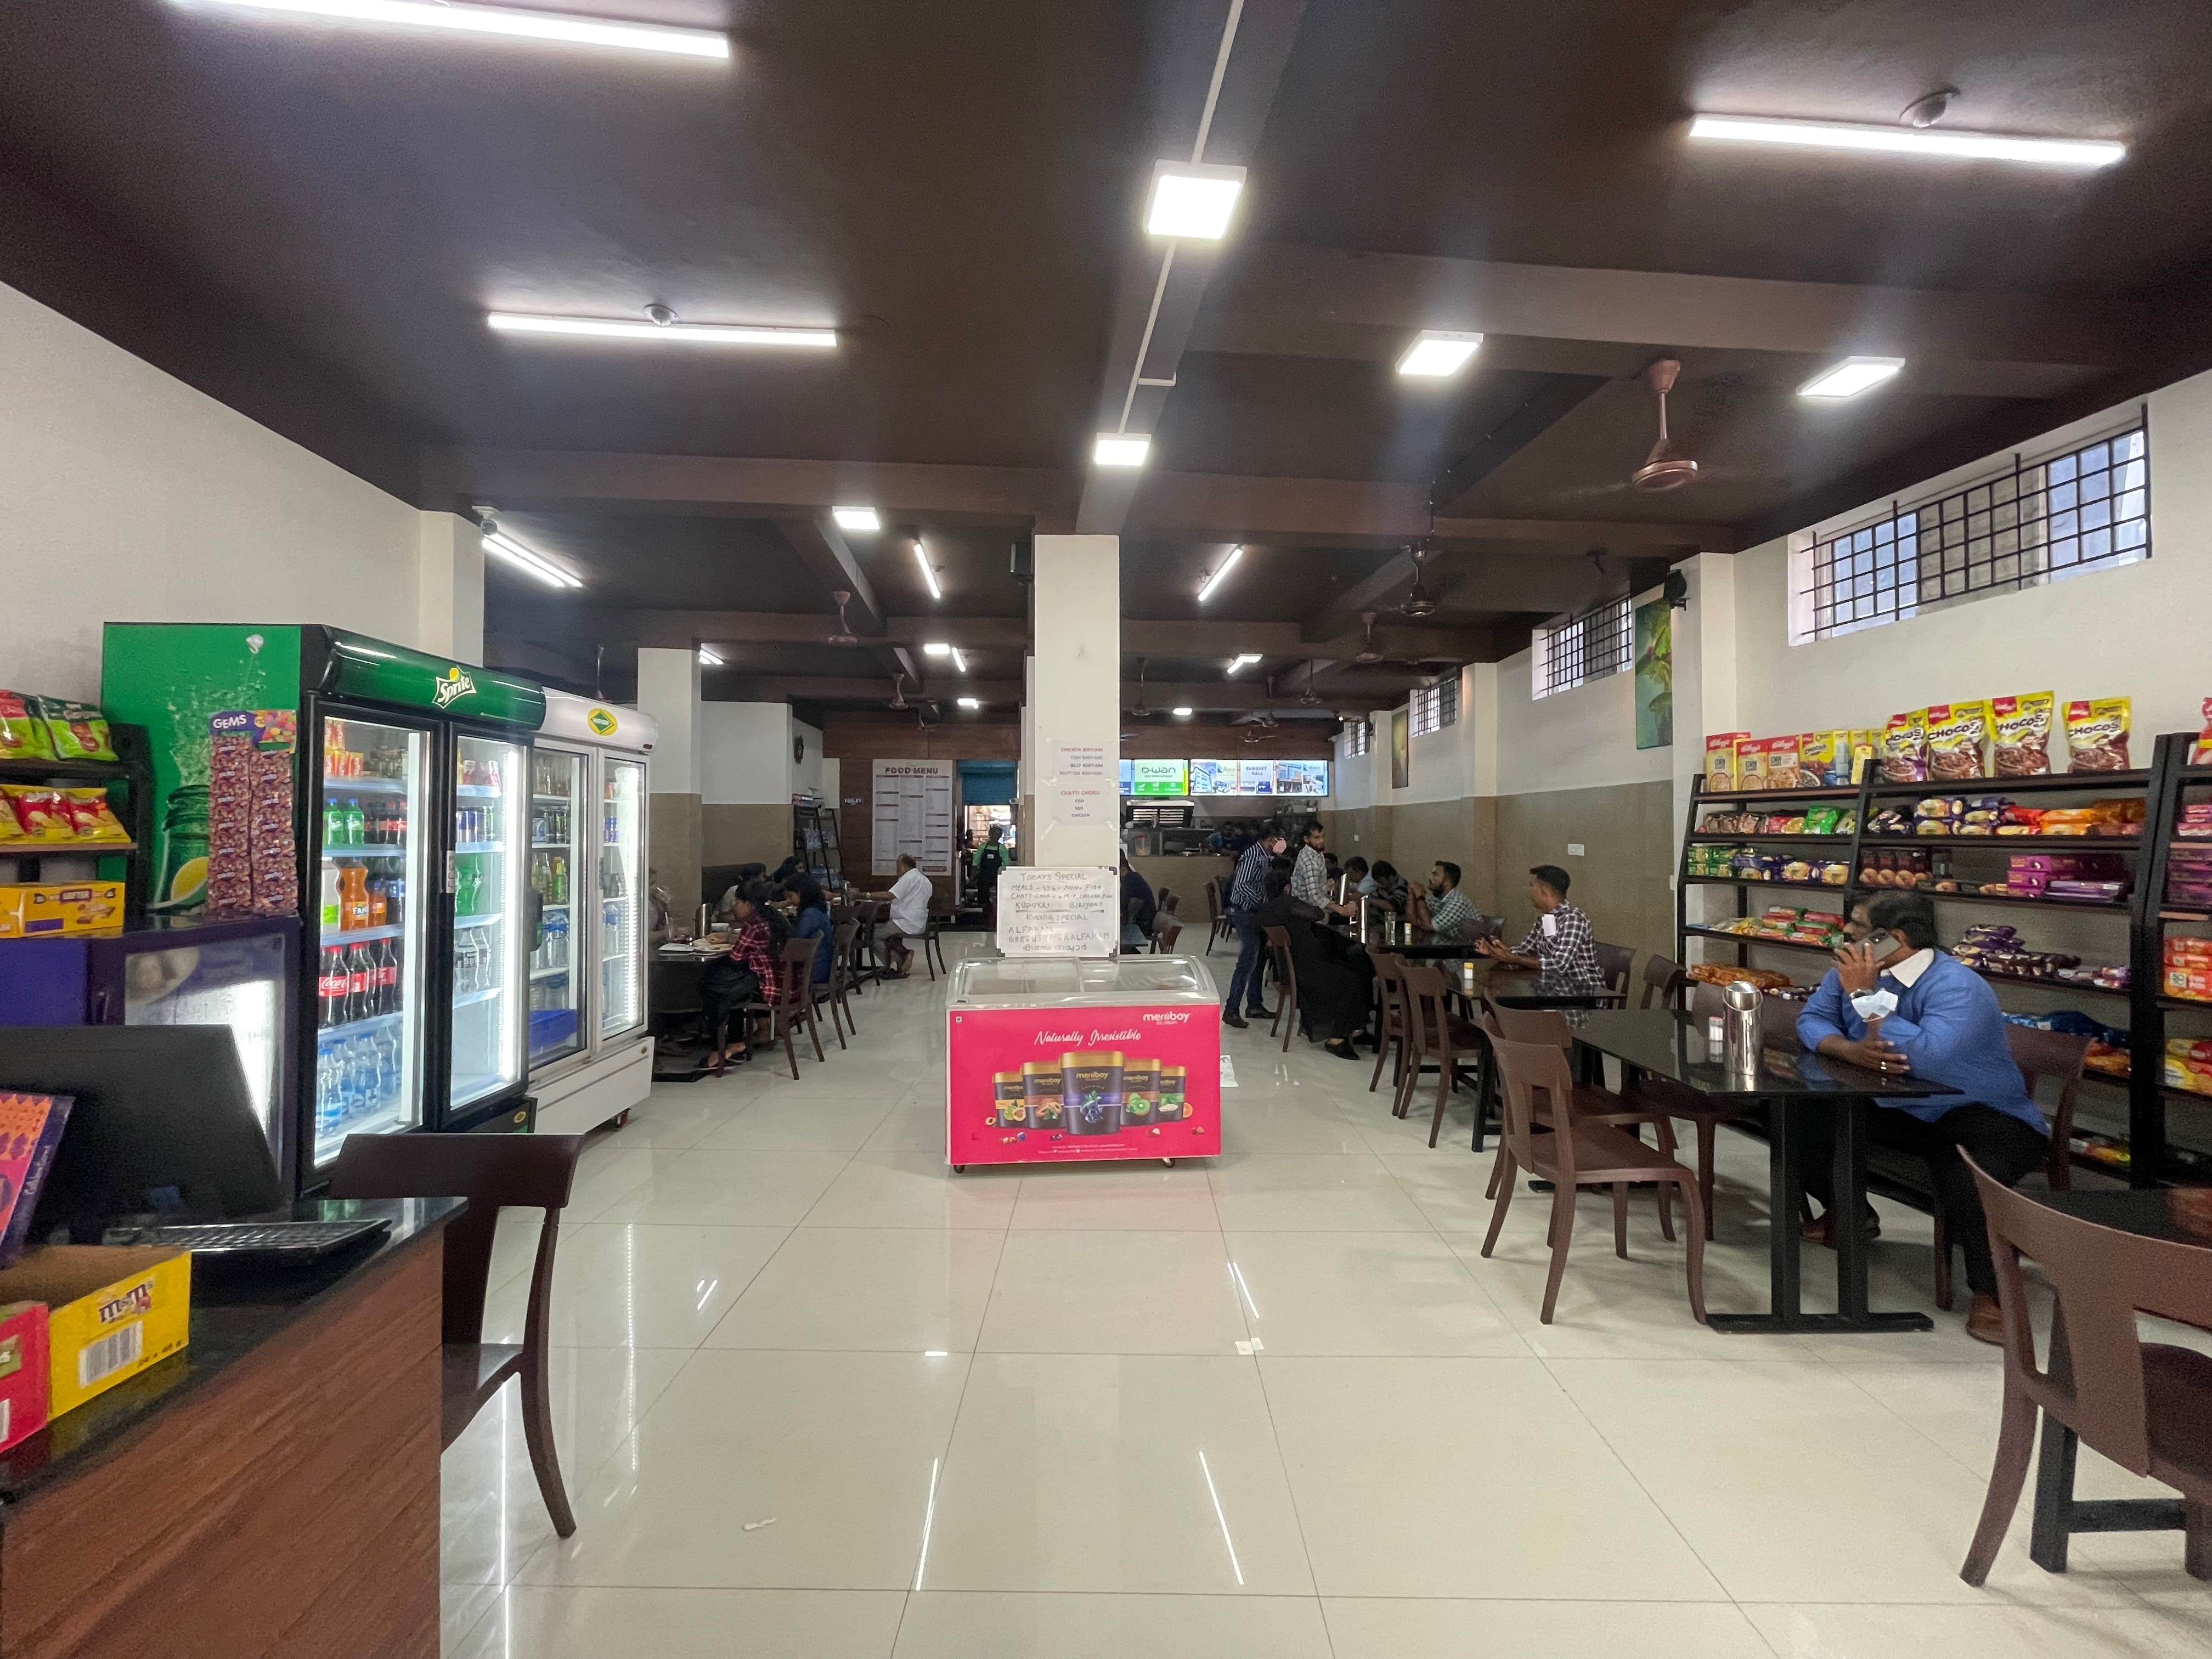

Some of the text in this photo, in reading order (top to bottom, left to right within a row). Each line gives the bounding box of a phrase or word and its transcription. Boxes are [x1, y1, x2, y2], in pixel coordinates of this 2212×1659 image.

[437, 675, 470, 703] Sprite
[213, 714, 247, 729] GEMS
[1055, 872, 1087, 881] SPECIAL
[1008, 935, 1037, 943] GREEN
[1034, 1028, 1142, 1047] Naturally Irresistible
